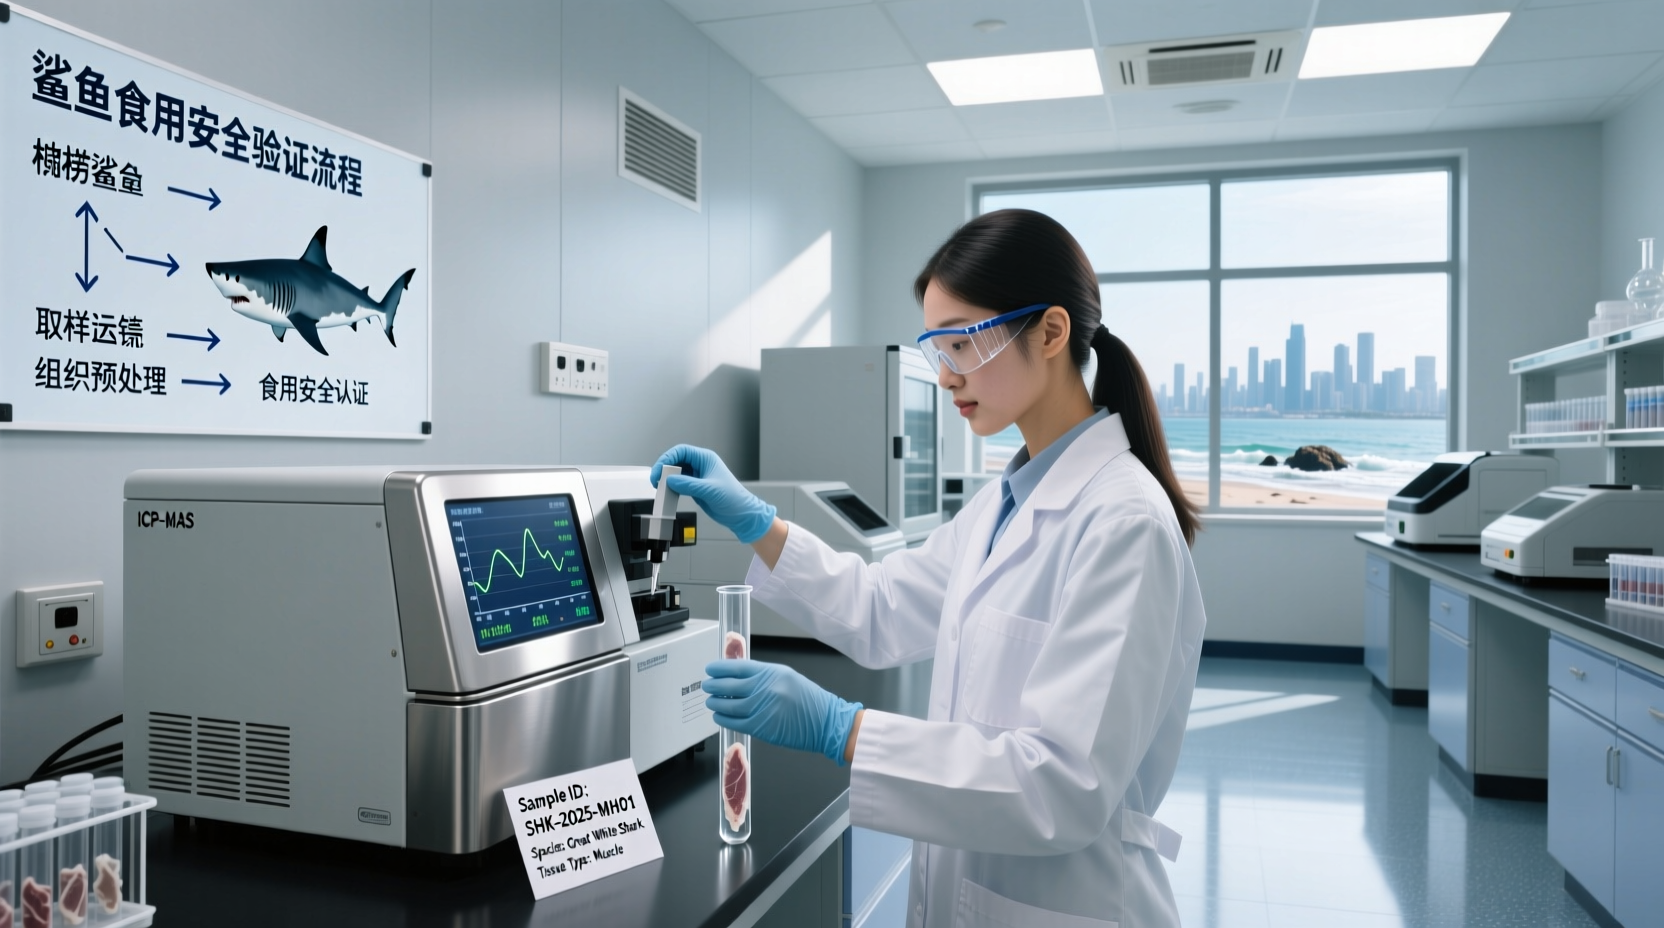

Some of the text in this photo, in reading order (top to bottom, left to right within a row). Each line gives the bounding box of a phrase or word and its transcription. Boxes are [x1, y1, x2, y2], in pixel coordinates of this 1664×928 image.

[32, 48, 363, 197] 鲨鱼食用安全验证流程
[35, 356, 167, 396] 组织预处理
[258, 372, 369, 406] 食用安全认证
[137, 511, 194, 529] ICP-MAS
[518, 788, 567, 813] Sample
[525, 794, 636, 836] SHK-2025-MH01
[537, 862, 567, 879] Tissue
